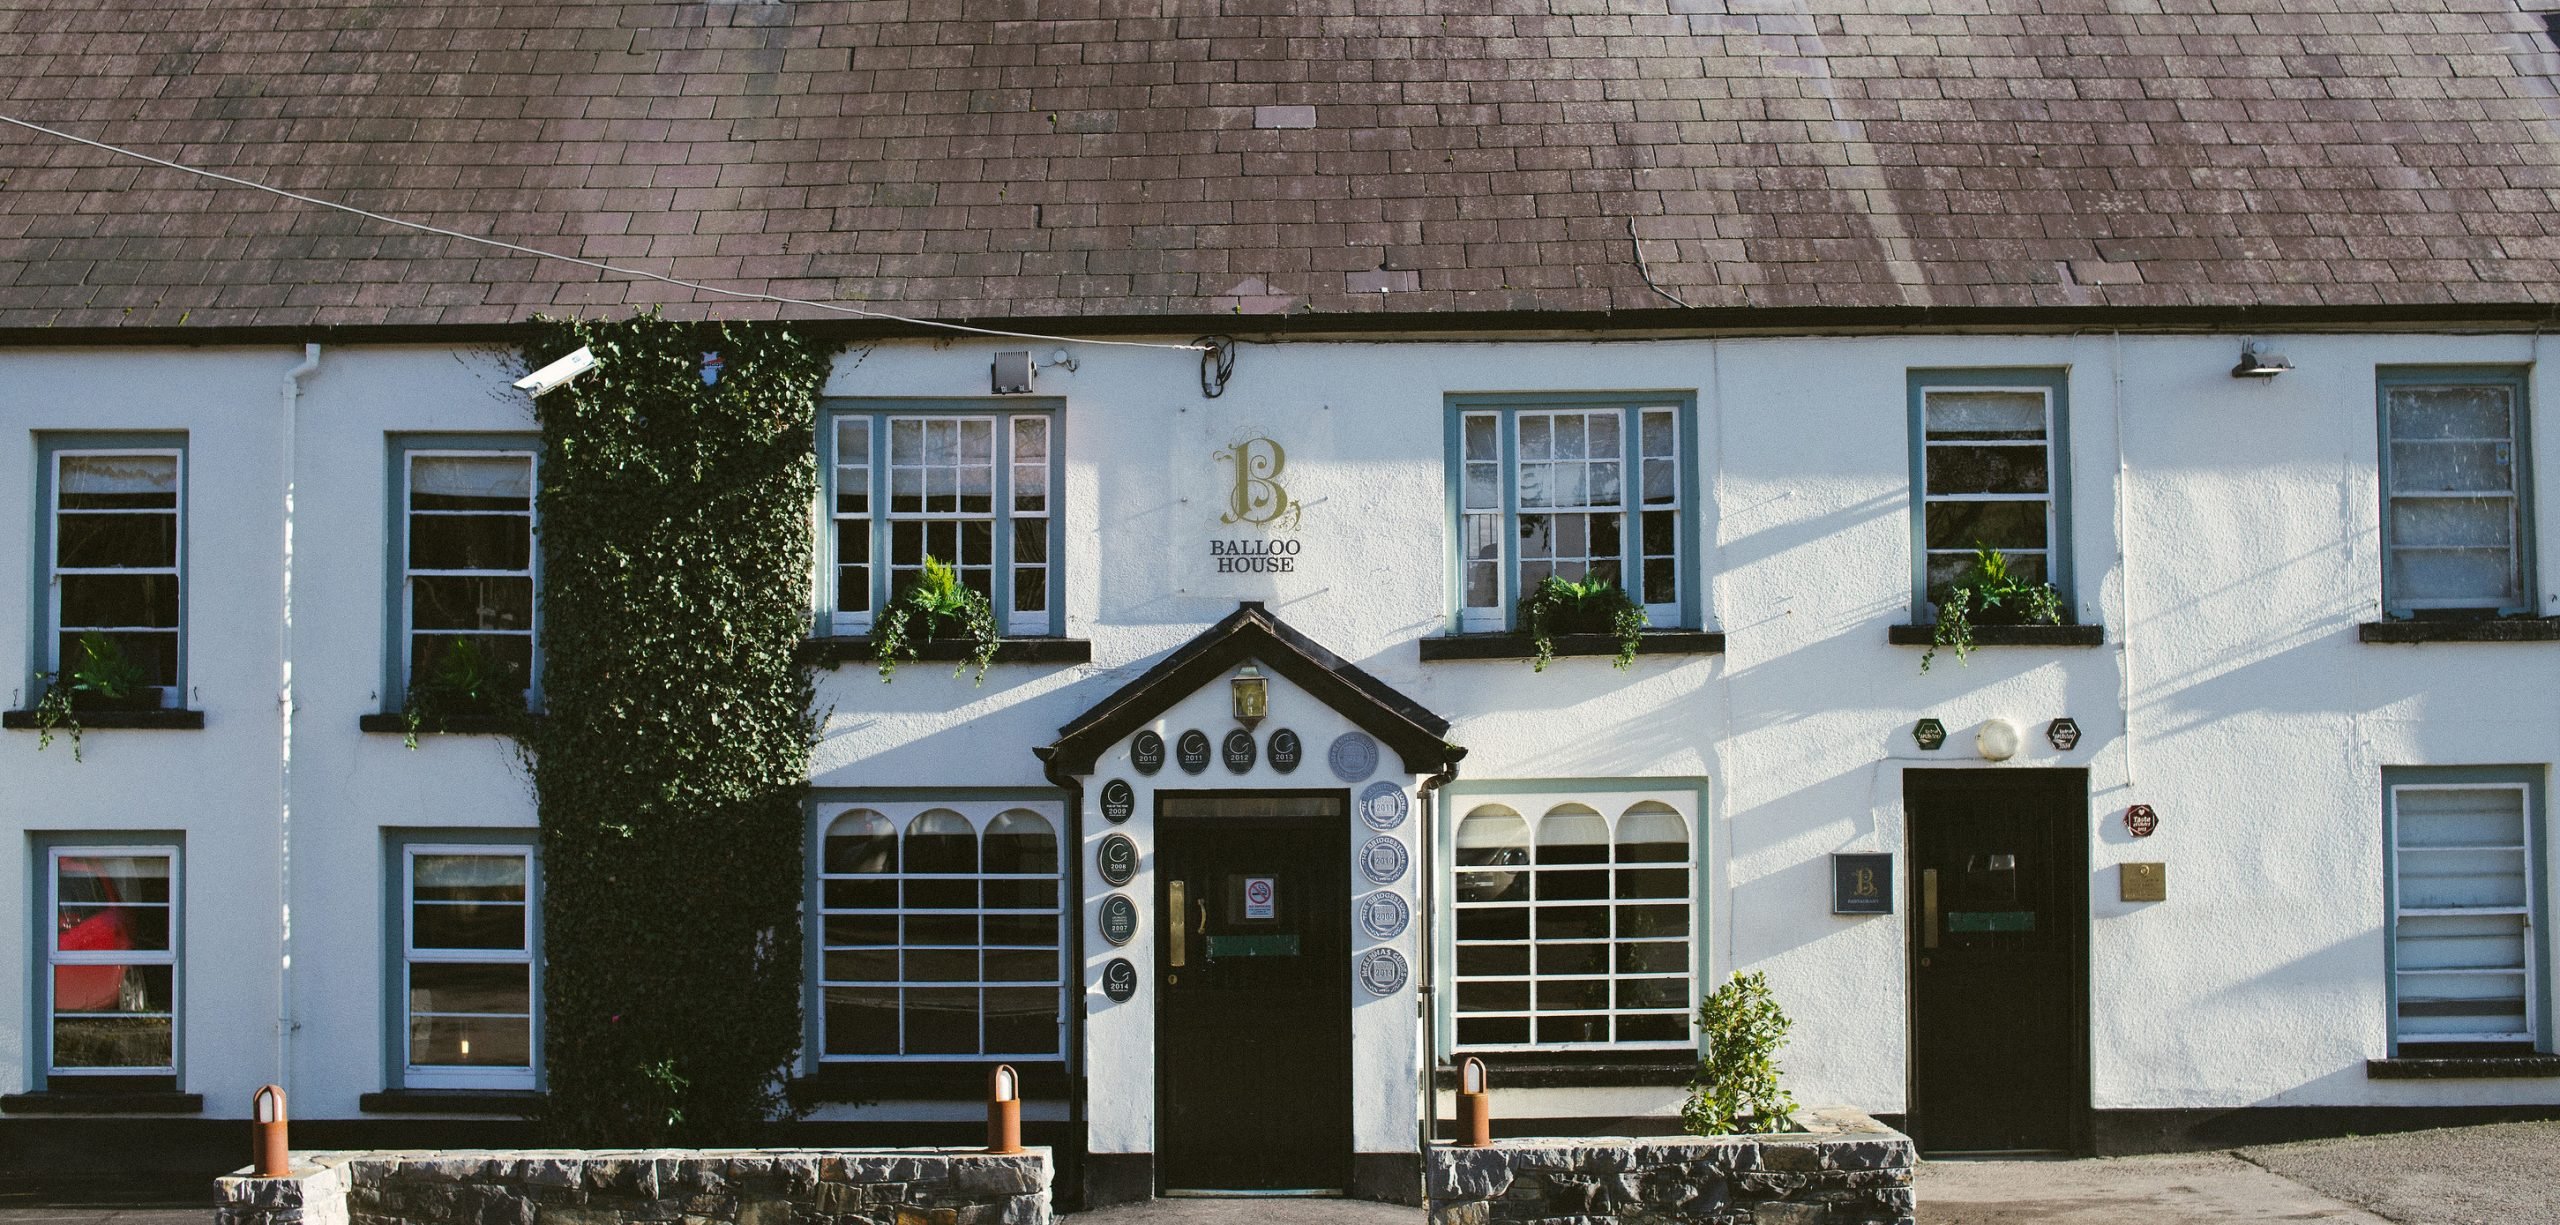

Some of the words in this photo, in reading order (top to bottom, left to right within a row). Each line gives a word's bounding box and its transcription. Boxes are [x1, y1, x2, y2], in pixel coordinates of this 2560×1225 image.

[1209, 539, 1301, 556] BALLOO
[1217, 557, 1294, 573] HOUSE
[1367, 837, 1407, 865] BRIDGESTONE
[1362, 904, 1370, 920] THE
[1368, 892, 1408, 920] BRIDGESTONE
